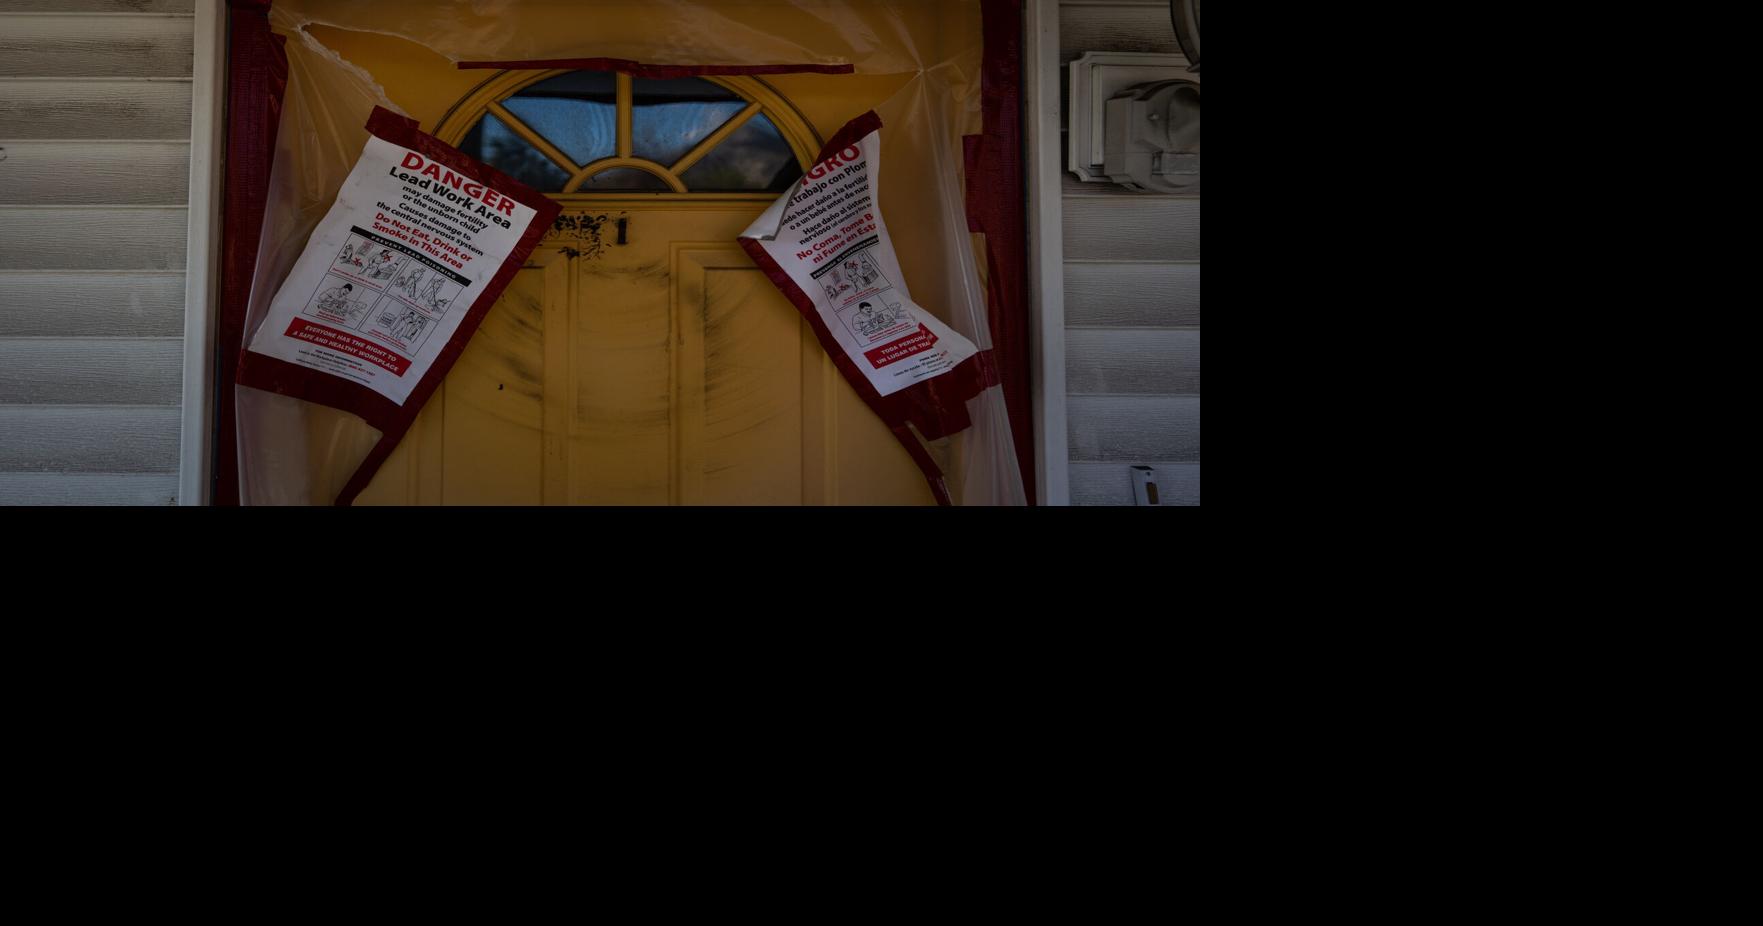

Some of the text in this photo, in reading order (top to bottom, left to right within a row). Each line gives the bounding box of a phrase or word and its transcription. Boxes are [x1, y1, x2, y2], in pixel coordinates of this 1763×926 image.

[389, 166, 512, 229] Lead Work Area
[400, 152, 515, 216] DANGER
[794, 182, 828, 203] trabajo
[828, 173, 845, 184] con
[398, 202, 472, 241] Causes damage to
[402, 186, 488, 229] may damage fertility
[402, 194, 480, 234] or the unborn child
[796, 203, 815, 217] hacer
[815, 194, 832, 206] daño
[802, 216, 810, 224] un
[810, 206, 827, 220] bebé
[826, 198, 844, 210] antes
[802, 222, 822, 235] Hace
[822, 213, 840, 225] daño
[840, 206, 847, 214] al
[372, 222, 463, 269] Smoke in This Area
[376, 202, 484, 256] the central nervous system
[376, 212, 472, 262] Do Not Eat, Drink or
[796, 249, 813, 260] No
[812, 233, 842, 251] Coma,
[840, 218, 865, 234] Tome
[799, 226, 832, 245] nervioso
[813, 254, 824, 264] ni
[822, 240, 846, 258] Fume
[846, 232, 858, 243] en
[370, 236, 402, 250] PREVENT
[421, 257, 457, 279] POISONING
[299, 332, 315, 340] SAFE
[314, 336, 328, 344] AND
[328, 340, 357, 354] HEALTHY
[359, 351, 400, 372] WORKPLACE
[305, 325, 337, 339] EVERYONE
[337, 334, 351, 343] HAS
[351, 339, 366, 348] THE
[366, 344, 387, 357] RIGHT
[387, 354, 397, 362] TO
